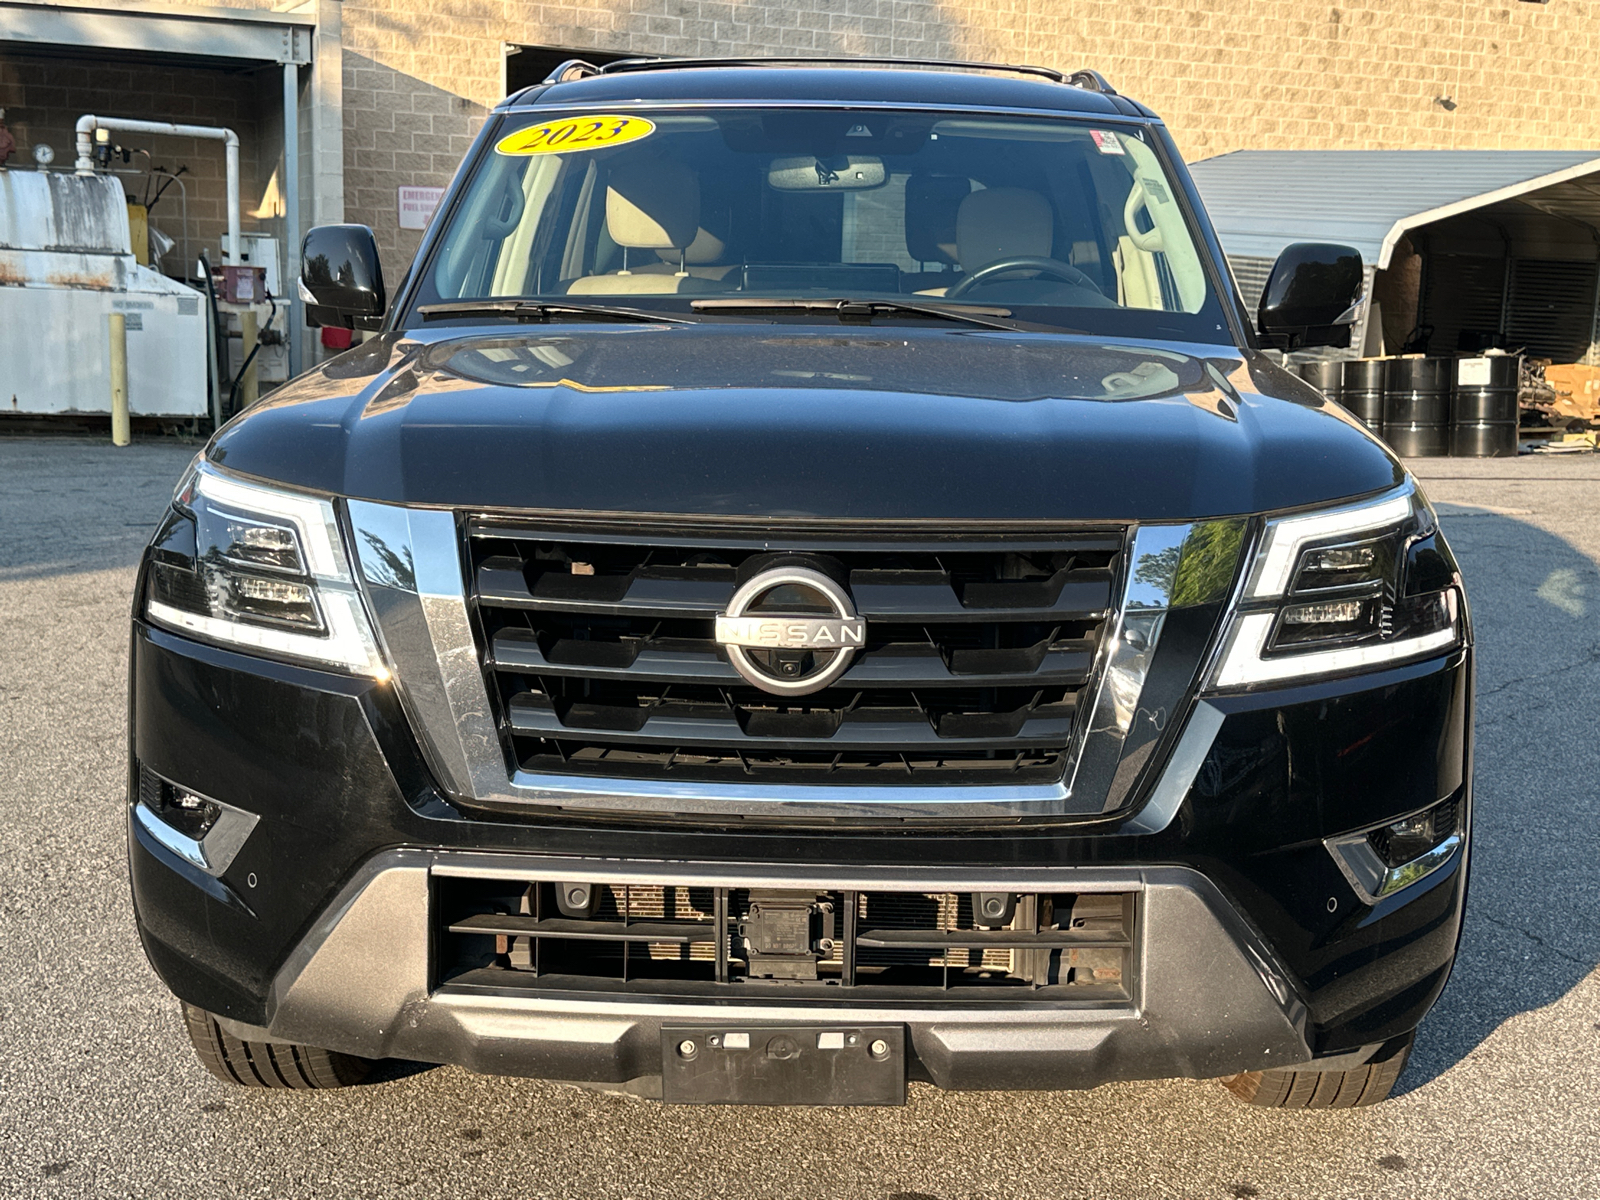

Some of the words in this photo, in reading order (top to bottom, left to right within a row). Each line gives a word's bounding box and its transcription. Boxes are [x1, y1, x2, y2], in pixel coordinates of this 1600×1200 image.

[517, 120, 629, 150] 2023
[403, 190, 441, 201] EMERGEN
[720, 622, 862, 643] NISSAN
